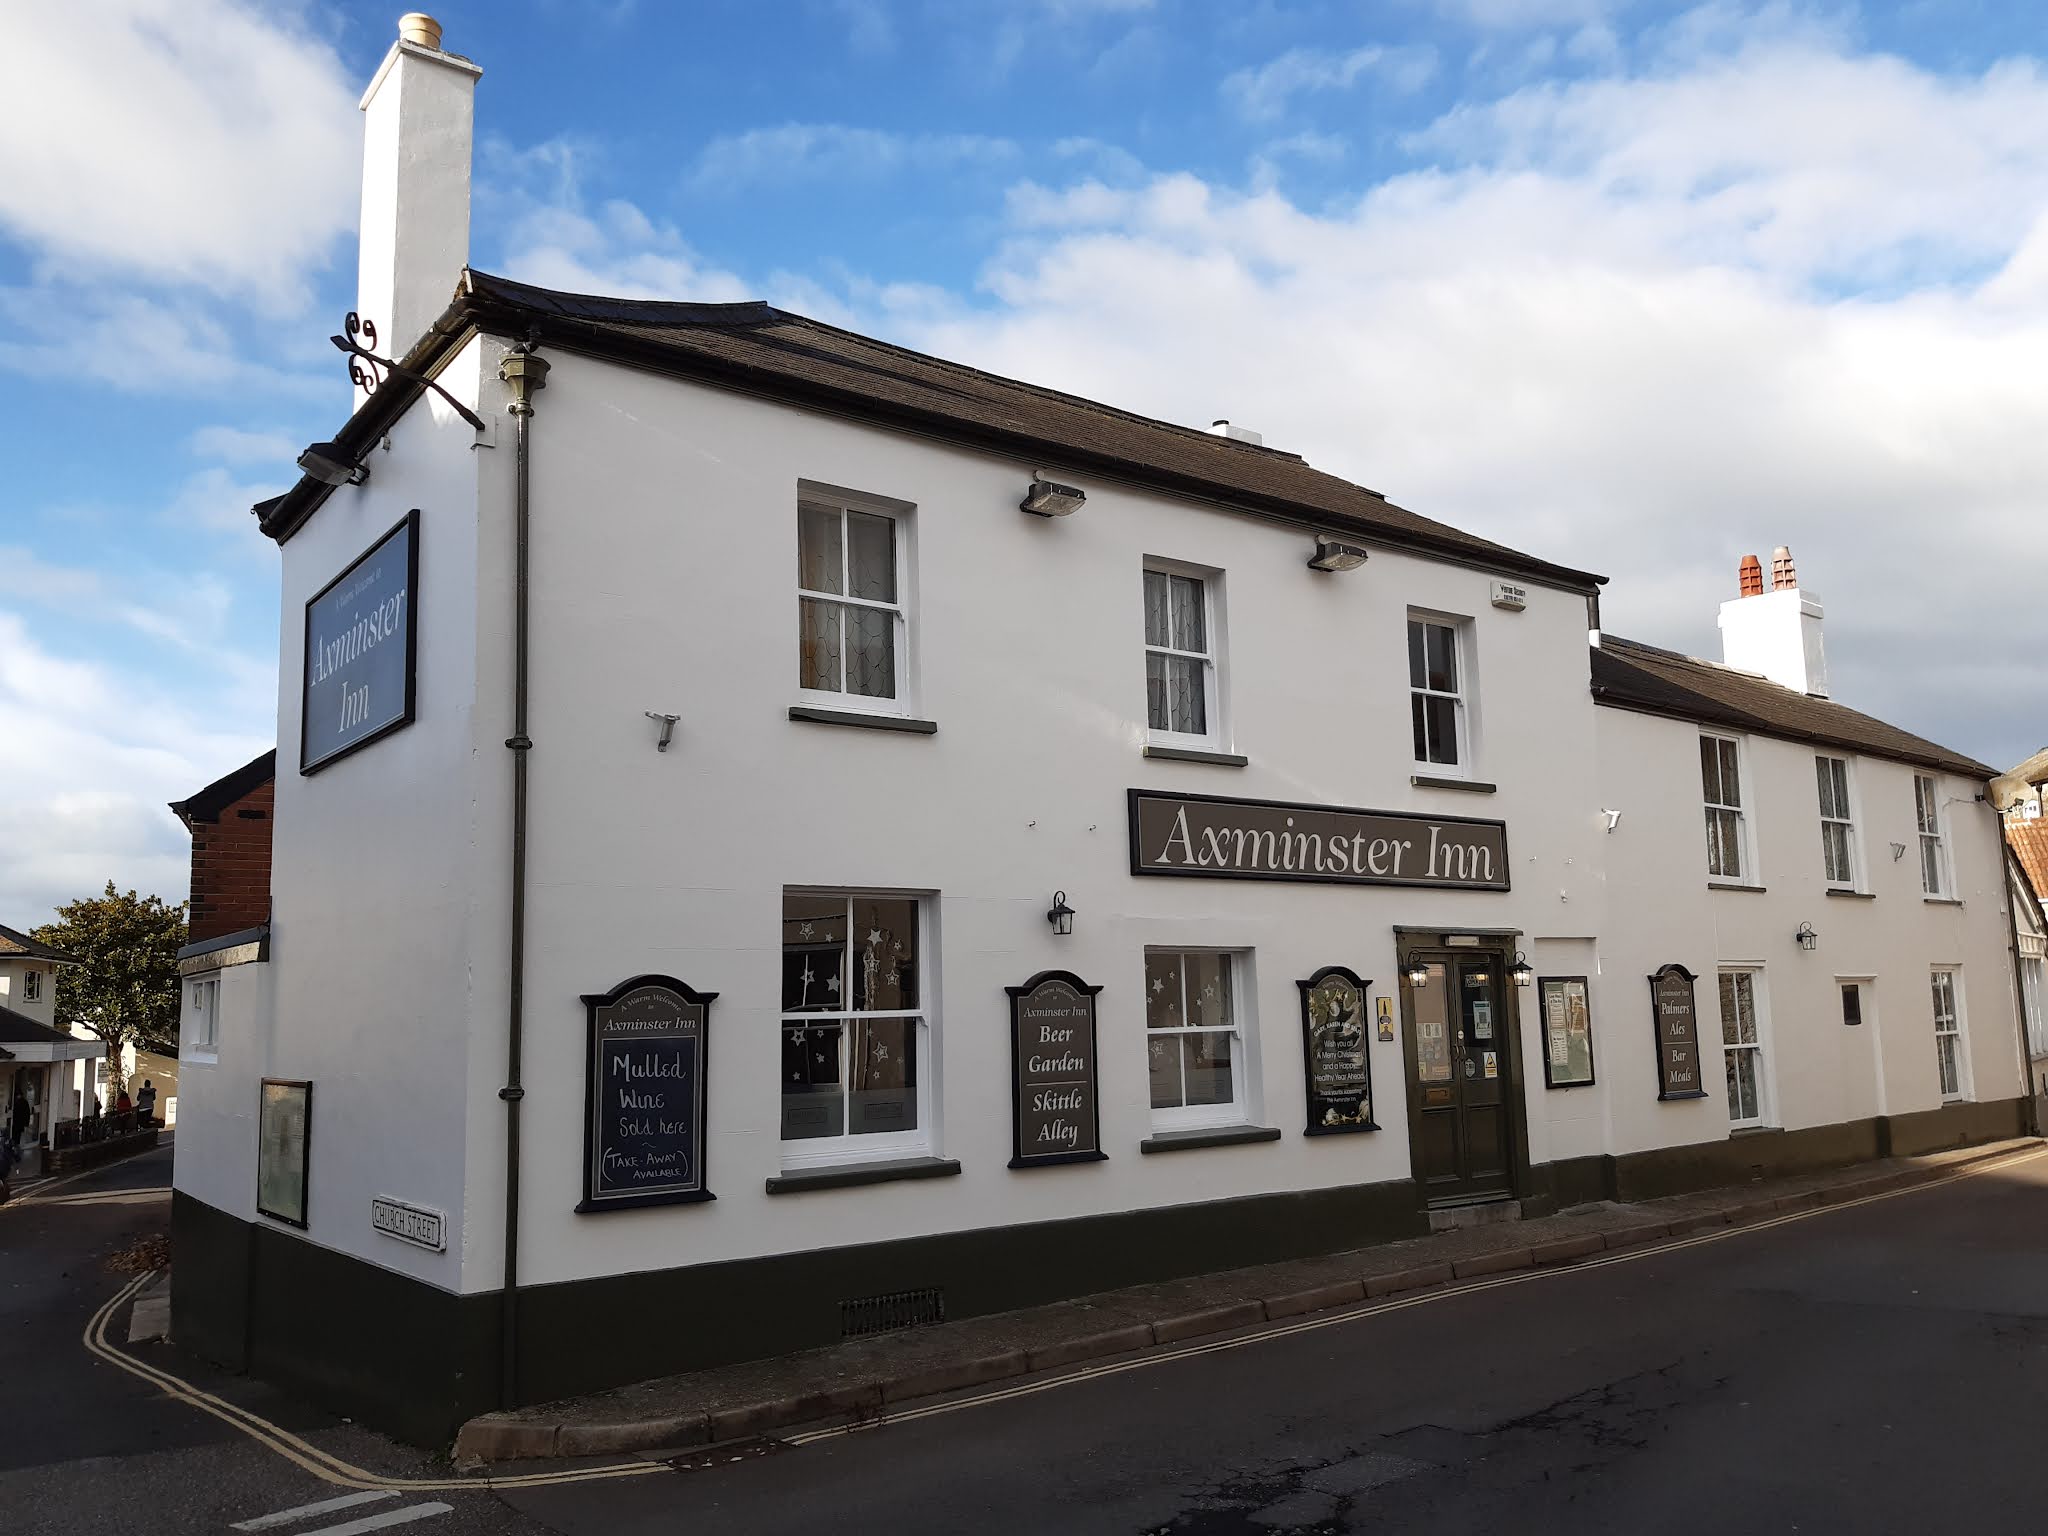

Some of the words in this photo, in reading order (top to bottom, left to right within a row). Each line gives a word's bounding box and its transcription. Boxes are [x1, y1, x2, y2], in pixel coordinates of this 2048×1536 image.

[310, 589, 406, 688] Axminster
[338, 680, 370, 733] Inn
[1154, 804, 1412, 876] Axminster
[1424, 825, 1495, 881] Inn
[627, 995, 651, 1006] Warm
[653, 994, 682, 1011] Welcome
[1661, 1000, 1690, 1015] Palmers
[1023, 1007, 1071, 1018] Axminster
[1072, 1006, 1088, 1017] Inn
[603, 1018, 672, 1031] Axminster
[674, 1016, 697, 1029] Inn
[1669, 1020, 1686, 1036] Ales
[1039, 1025, 1074, 1043] Beer
[1323, 1040, 1336, 1048] Wish
[1337, 1041, 1347, 1049] you
[1028, 1050, 1085, 1073] Garden
[1316, 1051, 1321, 1059] A
[1322, 1051, 1337, 1060] Merry
[1672, 1050, 1687, 1063] Bar
[612, 1052, 687, 1082] Mulled
[1669, 1067, 1692, 1083] Meals
[1314, 1073, 1334, 1082] Healthy
[619, 1088, 665, 1109] Wine
[1032, 1088, 1083, 1112] Skittle
[619, 1117, 654, 1137] Sold
[659, 1117, 688, 1134] here
[1036, 1118, 1079, 1148] Alley
[375, 1206, 405, 1230] CHURCH
[407, 1214, 436, 1240] STREET
